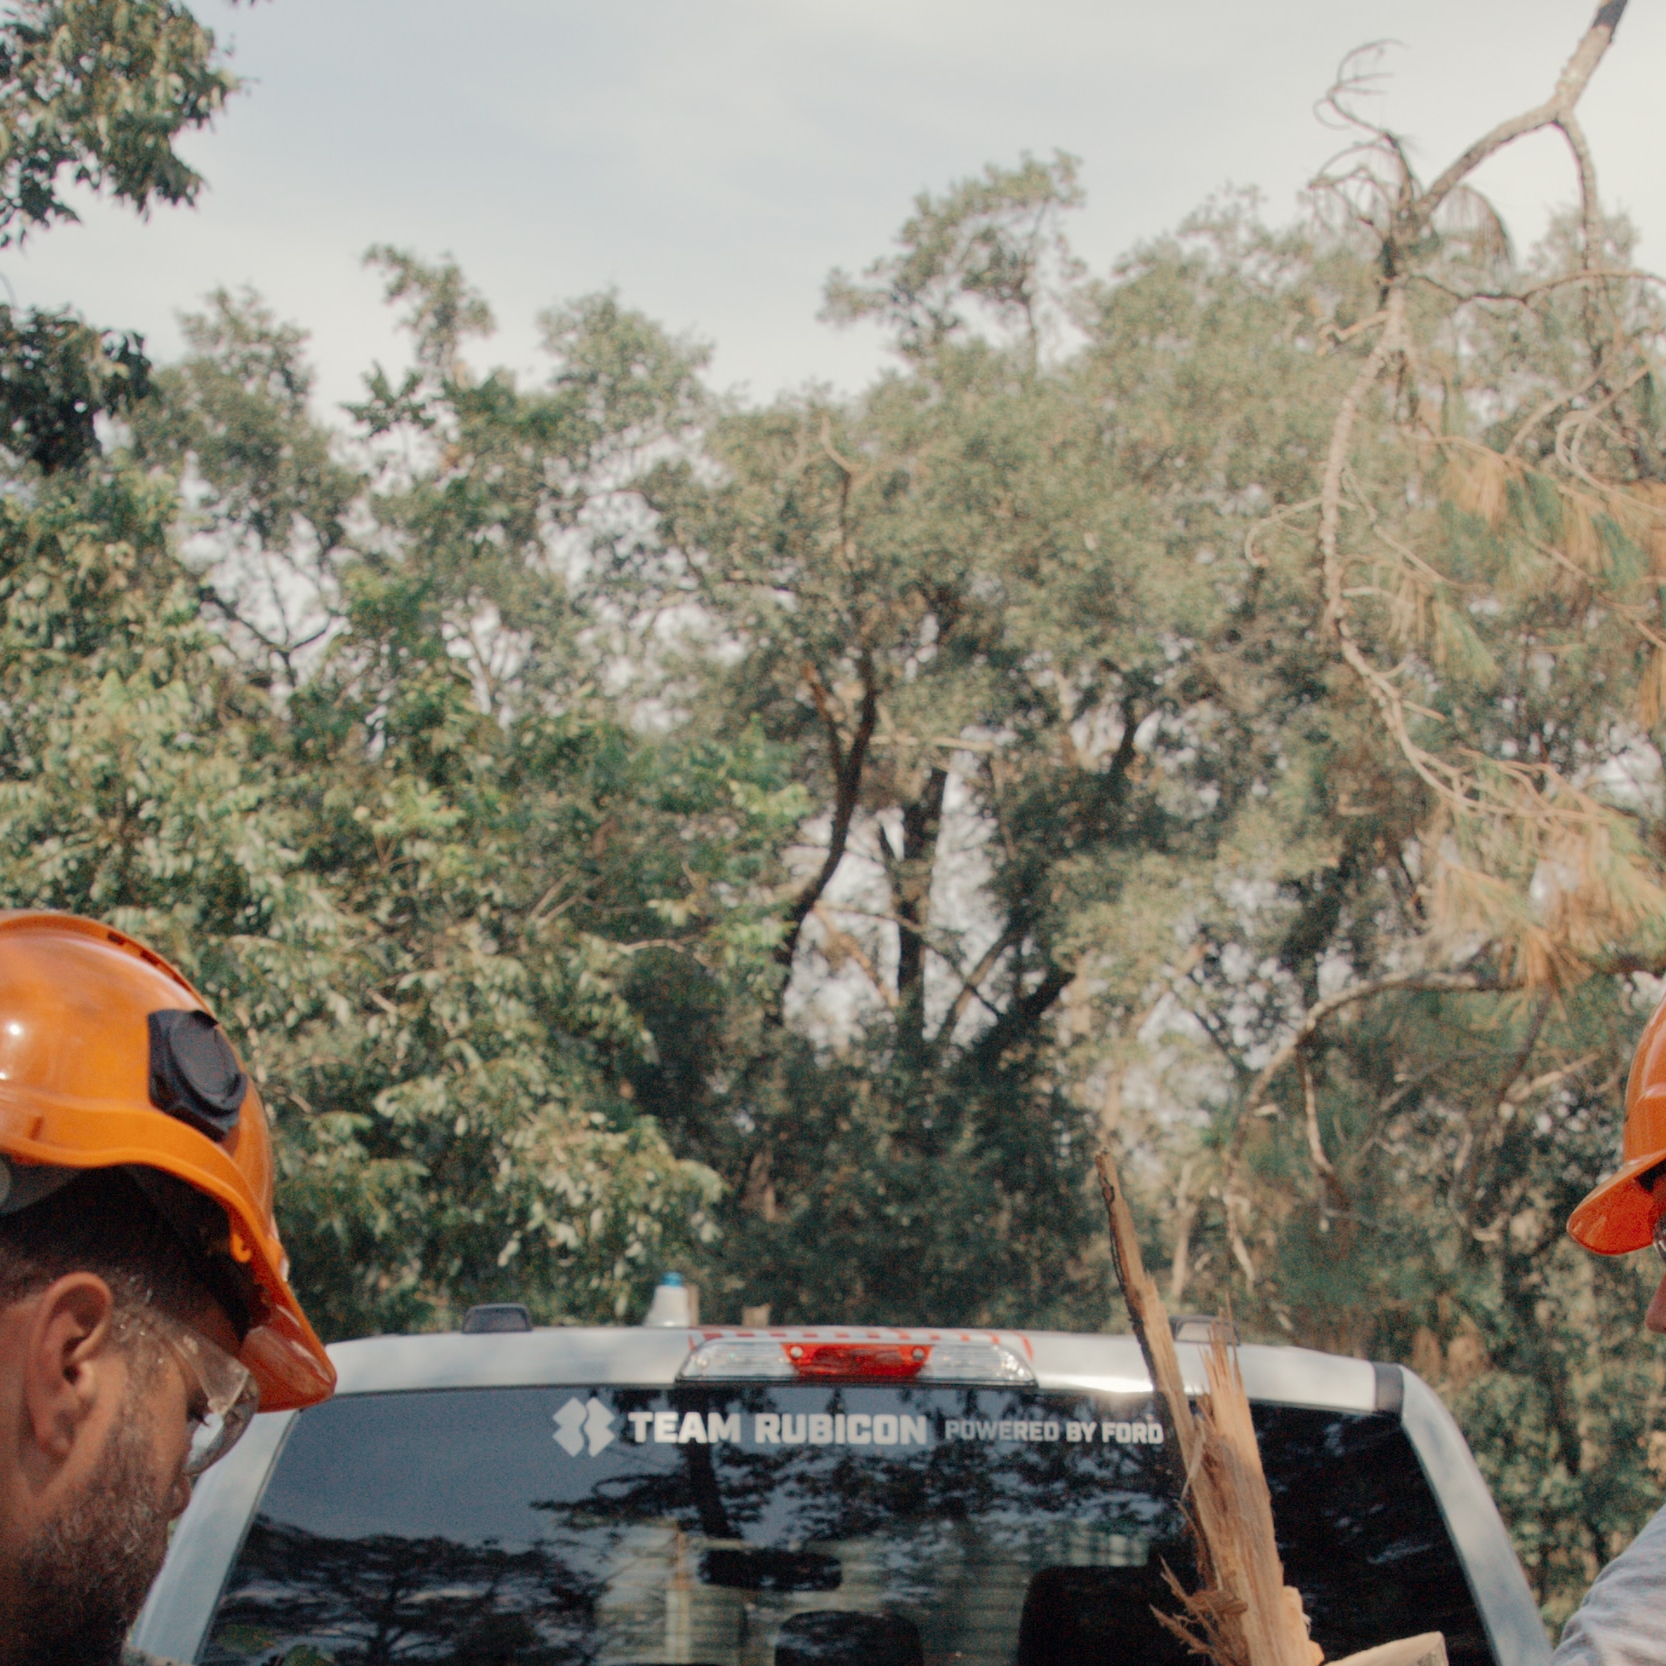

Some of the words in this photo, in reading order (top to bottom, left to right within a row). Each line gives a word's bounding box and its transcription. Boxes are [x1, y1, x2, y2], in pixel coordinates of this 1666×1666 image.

[628, 1412, 741, 1445] TEAM
[755, 1413, 927, 1446] RUBICON
[945, 1420, 1060, 1442] POWERED
[1066, 1421, 1097, 1443] BY
[1102, 1422, 1164, 1445] FORD
